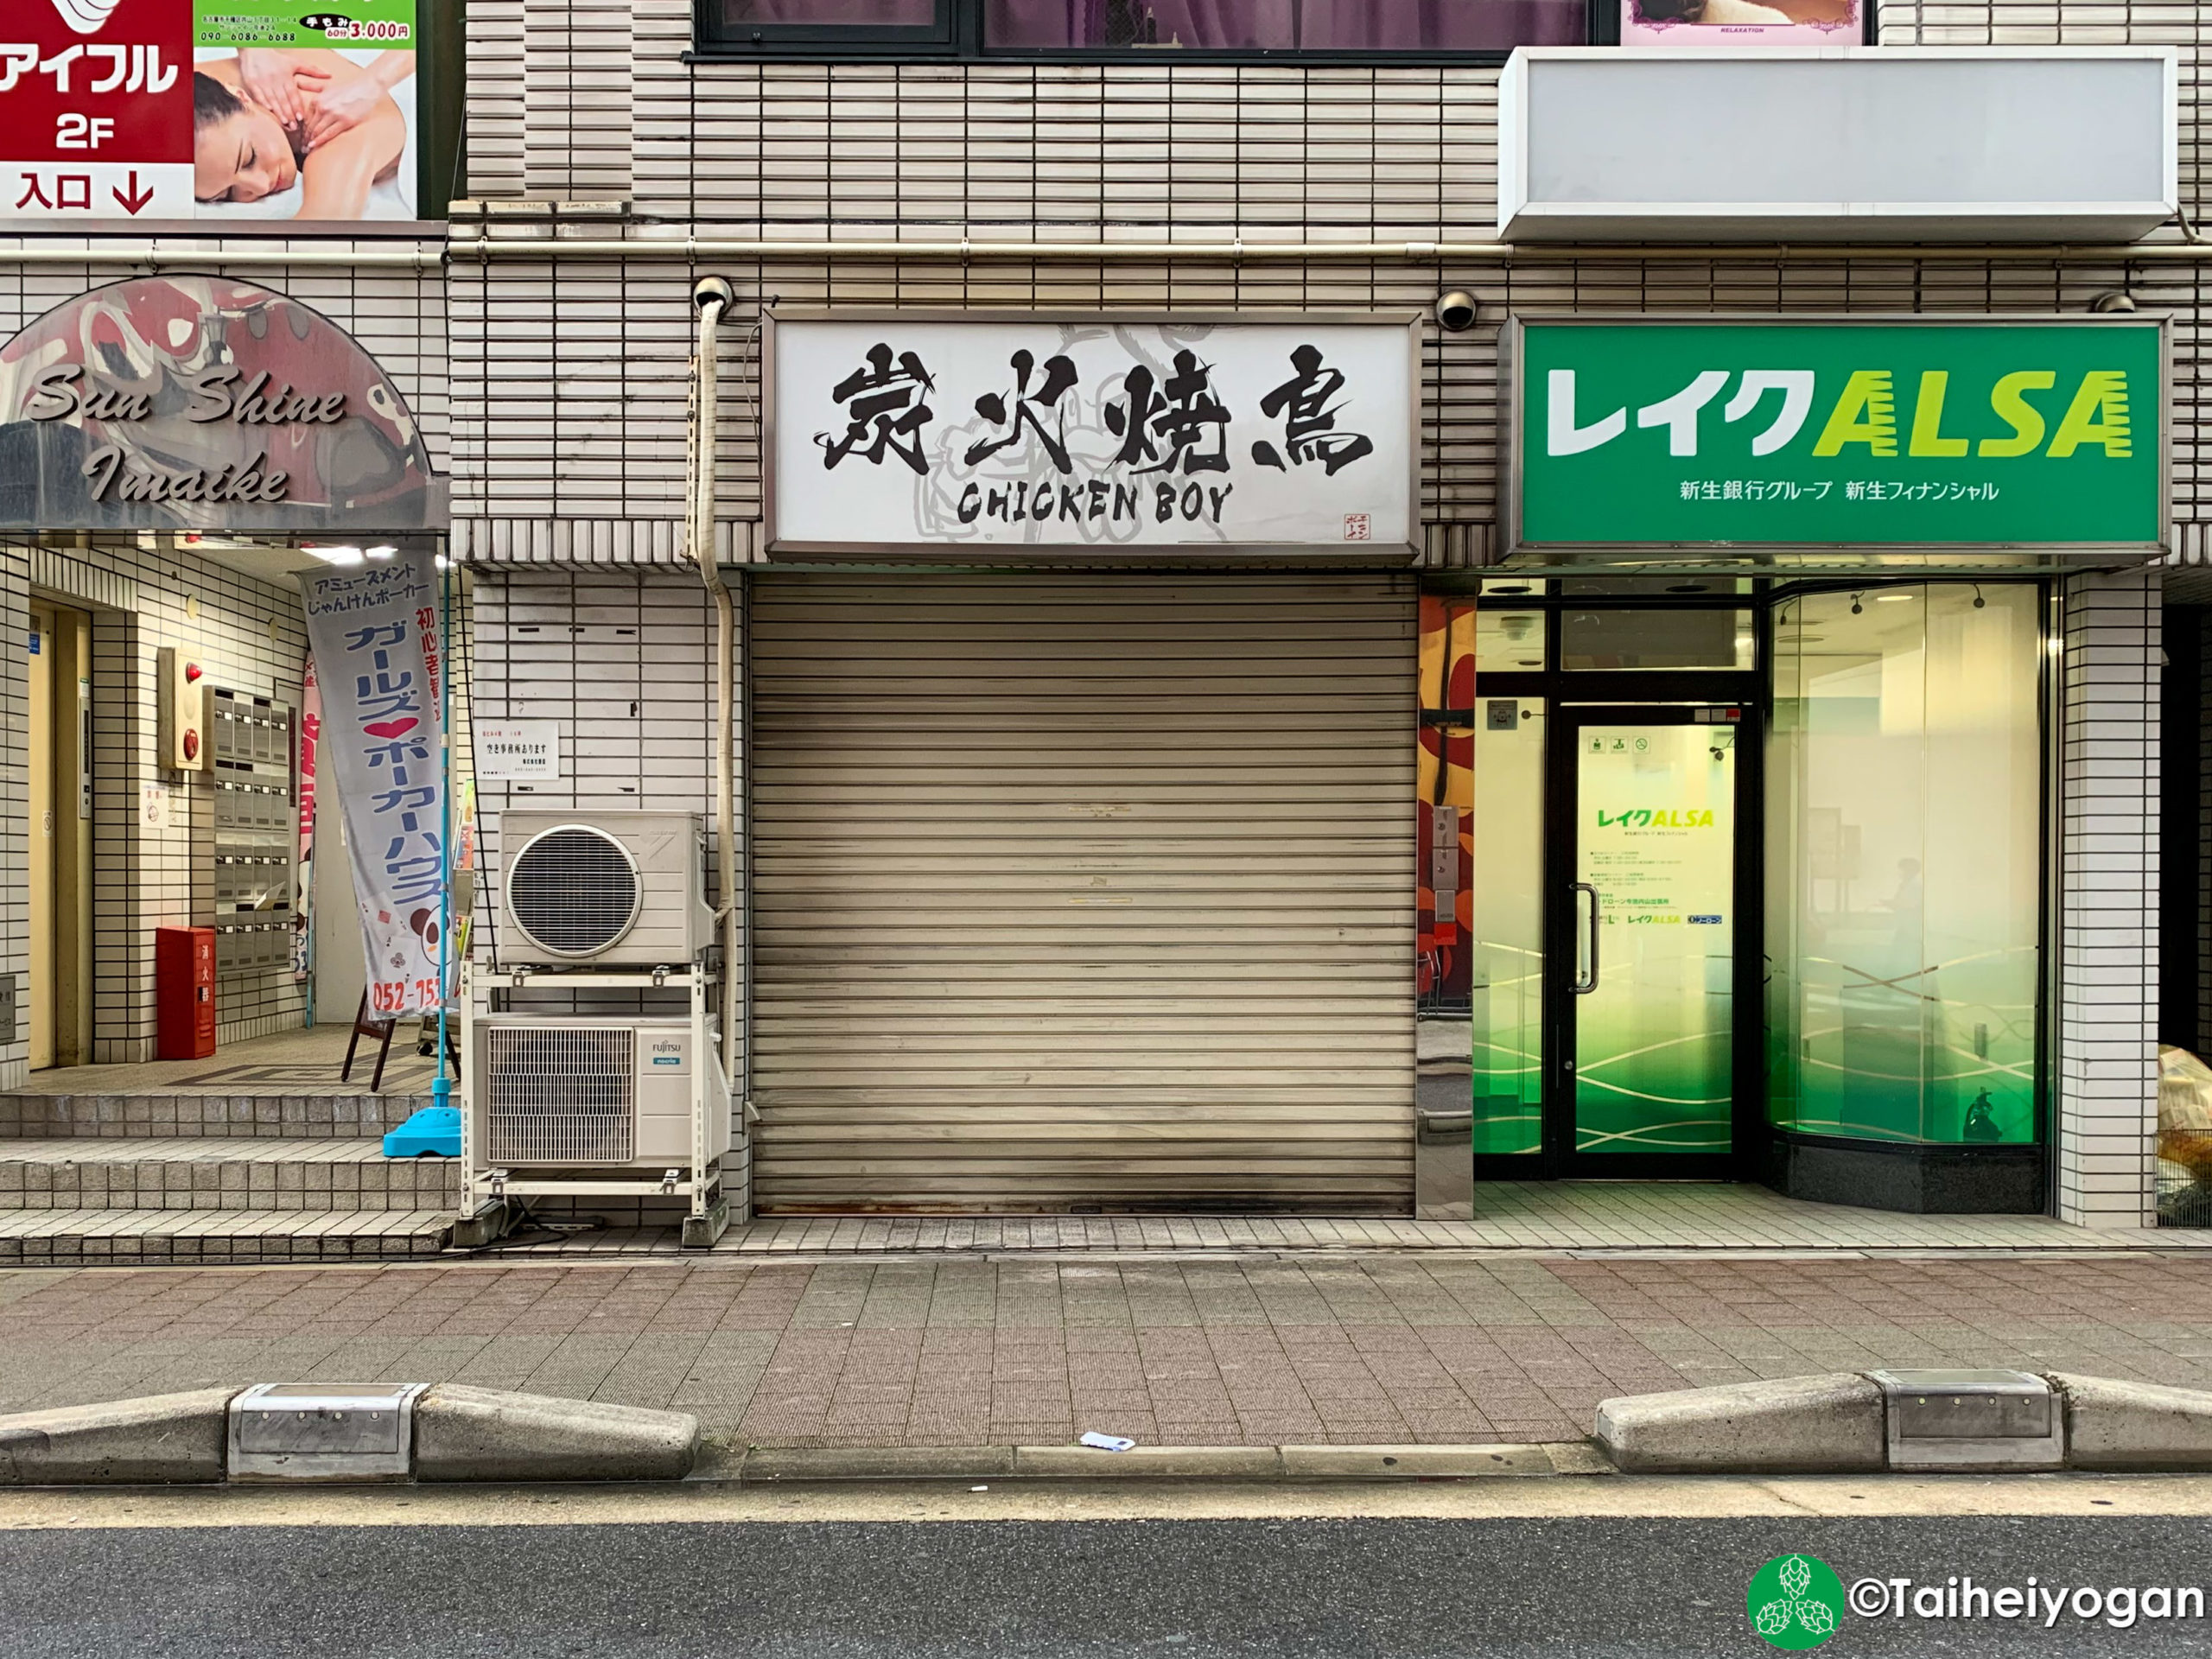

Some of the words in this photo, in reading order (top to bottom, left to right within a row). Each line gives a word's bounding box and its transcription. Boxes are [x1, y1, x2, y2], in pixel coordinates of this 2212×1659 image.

[306, 16, 348, 27] 手もみ
[327, 29, 347, 37] 60分
[0, 43, 178, 93] アイフル
[55, 113, 114, 149] 2F
[16, 172, 92, 210] 入口
[26, 364, 152, 423] Sun
[183, 364, 347, 424] Shine
[813, 342, 1376, 476] 炭火焼鳥
[1547, 369, 2134, 458] レイクALSA
[82, 445, 292, 503] Imaike
[1680, 480, 1833, 500] 新生銀行グループ
[1846, 480, 1999, 500] 新生フィナンシャル
[957, 480, 1141, 524] CHICKEN
[1154, 480, 1234, 524] BOY
[315, 563, 416, 595] アミューズメント
[308, 583, 429, 616] じゃんけんポーカー
[344, 620, 420, 721] ガールズ
[363, 736, 442, 906] ポーカーハウス
[1598, 810, 1713, 827] レイクALSA
[652, 1039, 681, 1053] FUJITSU
